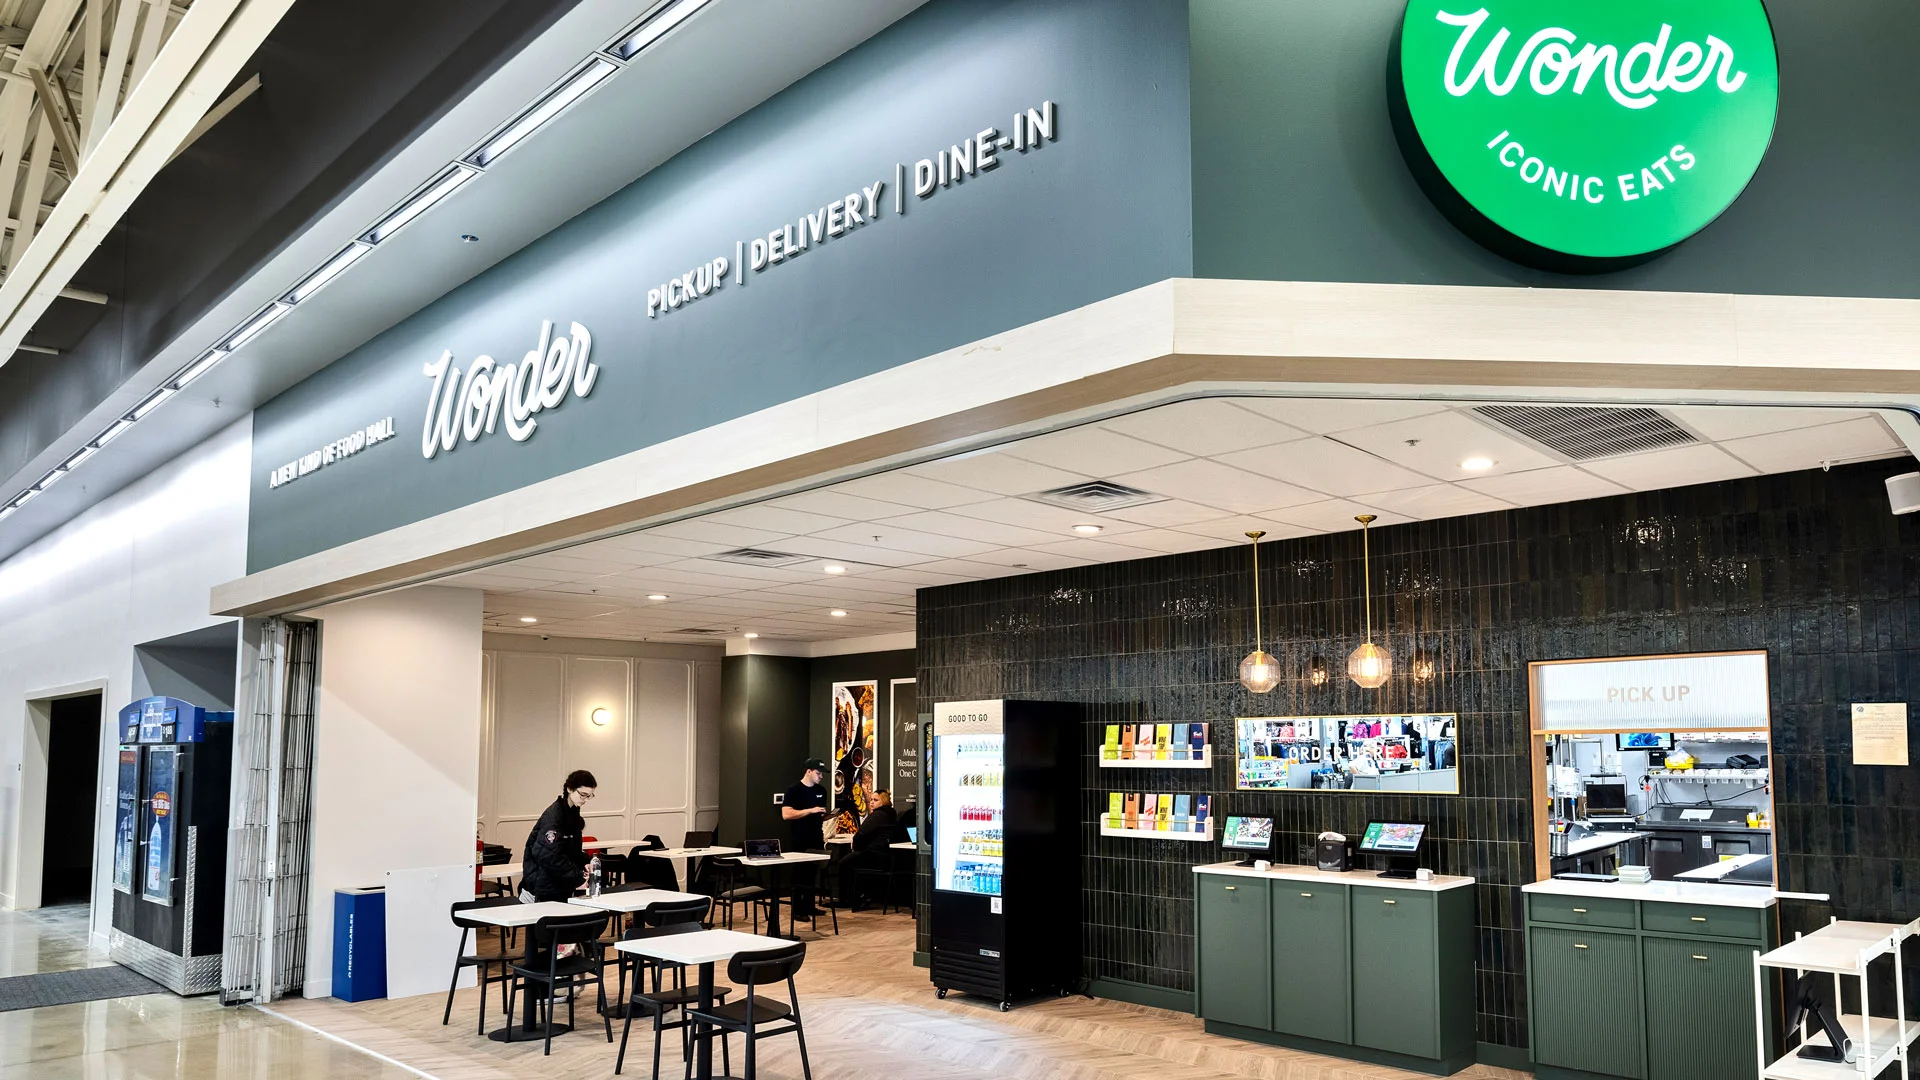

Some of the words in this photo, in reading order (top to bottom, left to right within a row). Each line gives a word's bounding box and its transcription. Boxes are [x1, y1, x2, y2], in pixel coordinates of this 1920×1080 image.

[1436, 7, 1748, 110] Wonder
[1487, 130, 1605, 204] ICONIC
[1618, 144, 1697, 202] EATS
[648, 257, 729, 319] PICKUP
[751, 181, 884, 272] DELIVERY
[915, 100, 1053, 198] DINE-IN
[422, 319, 600, 459] Wonder
[270, 471, 278, 489] A
[278, 460, 298, 485] NEW
[298, 451, 322, 476] KIND
[322, 442, 337, 465] OF
[337, 431, 366, 459] FOOD
[366, 416, 396, 446] HALL
[948, 715, 966, 723] GOOD
[968, 714, 977, 722] TO
[978, 713, 988, 722] GO
[1606, 686, 1655, 703] PICK
[1662, 685, 1690, 702] UP
[899, 769, 911, 777] One
[1289, 746, 1343, 761] ORDER
[1349, 746, 1395, 760] HERE
